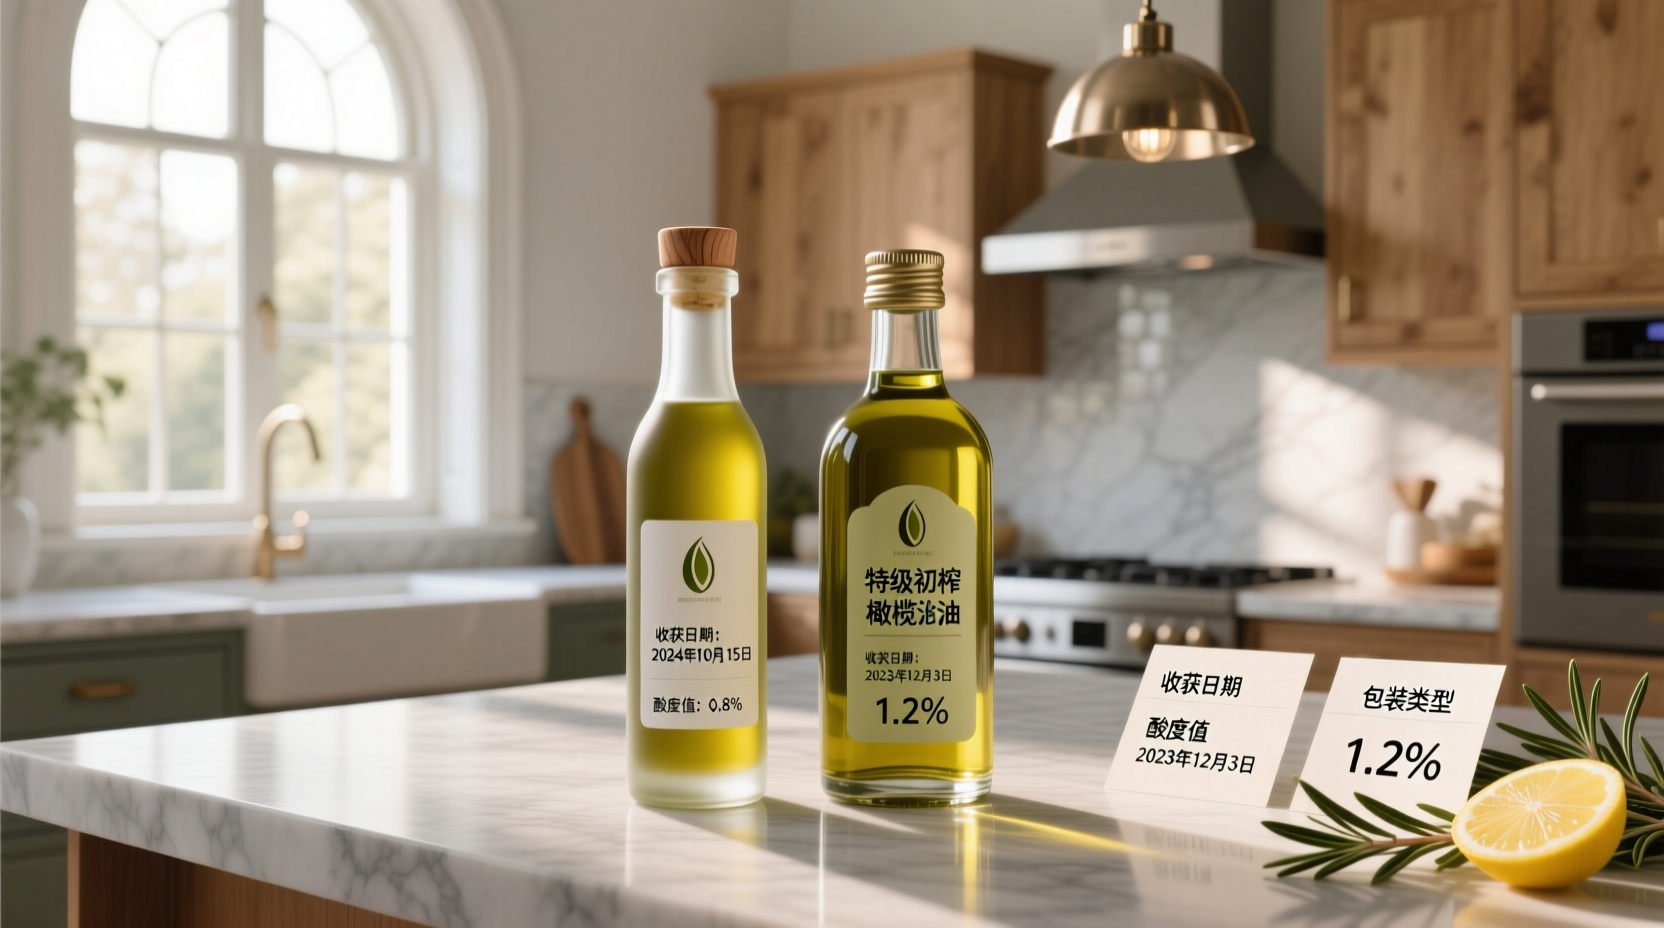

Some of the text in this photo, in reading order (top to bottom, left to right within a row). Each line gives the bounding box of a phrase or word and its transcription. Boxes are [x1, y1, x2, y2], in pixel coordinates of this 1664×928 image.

[864, 566, 961, 595] 特级初榨
[1160, 670, 1243, 698] 收获日期
[876, 696, 949, 725] 1.2%
[1363, 685, 1455, 714] 包装类型
[1145, 716, 1211, 743] 酸度值
[1135, 747, 1256, 775] 2023年12月3日
[1347, 738, 1442, 781] 1.2%
